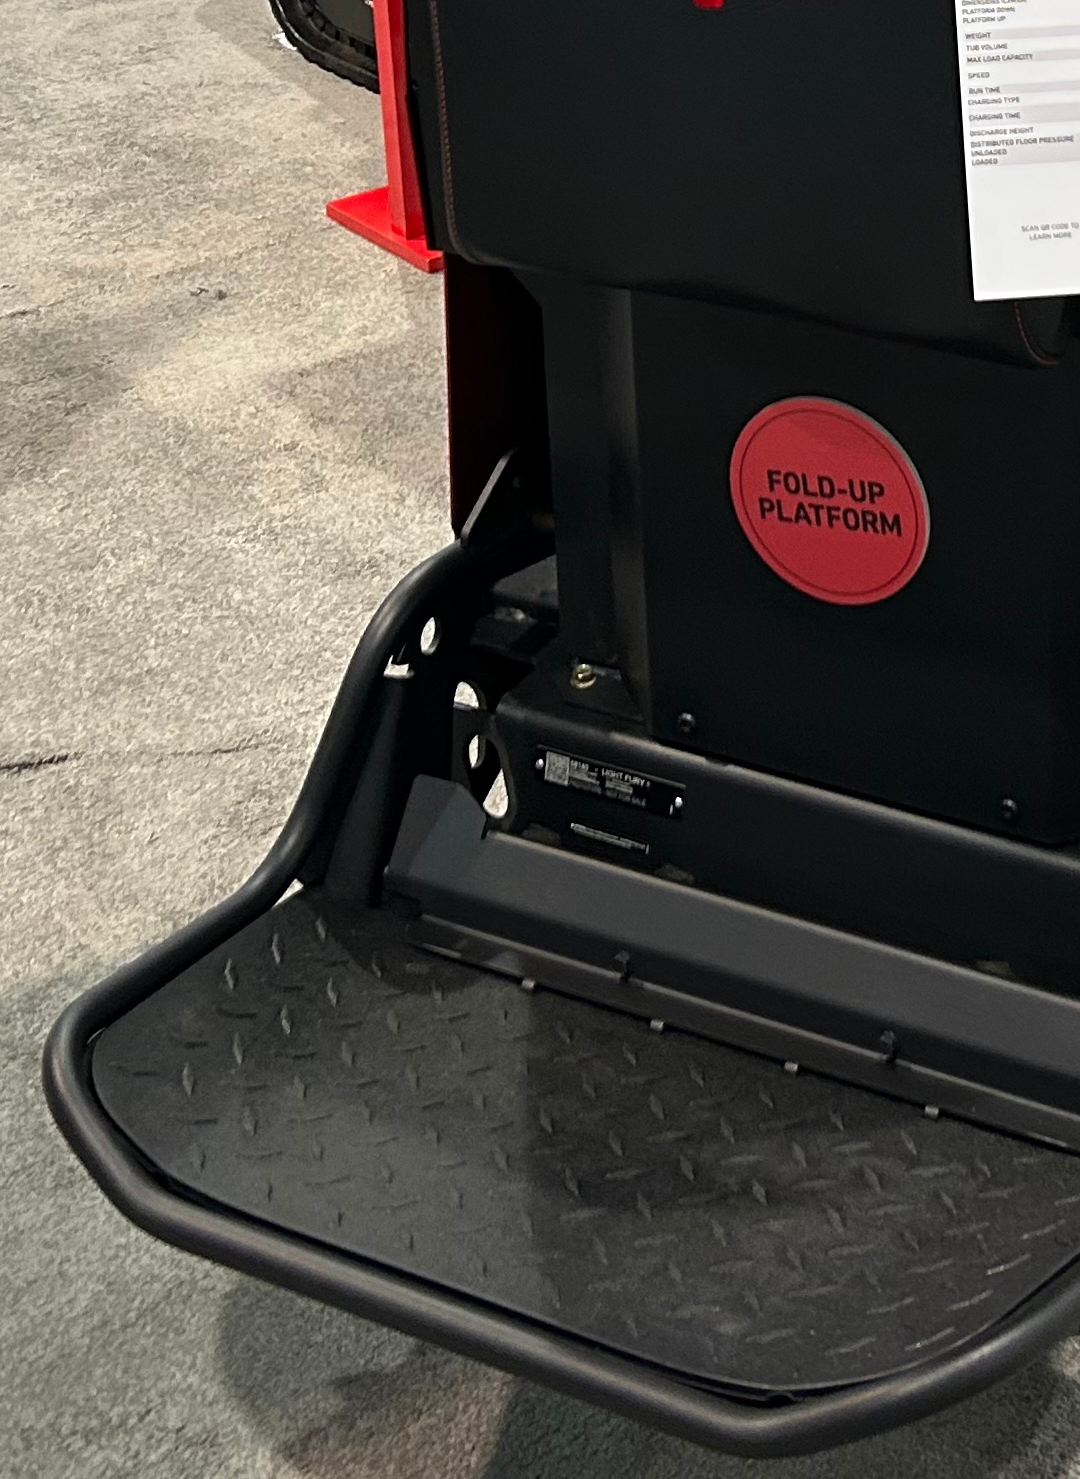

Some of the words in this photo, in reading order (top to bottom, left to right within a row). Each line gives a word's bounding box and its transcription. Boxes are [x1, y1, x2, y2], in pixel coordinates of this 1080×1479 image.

[967, 71, 990, 79] SPEED
[971, 157, 998, 166] LOADED
[1021, 224, 1039, 232] SCAN
[1050, 222, 1068, 230] CODE
[1028, 232, 1051, 240] LEARN
[1053, 231, 1071, 239] MORE
[766, 469, 885, 504] FOLD-UP
[758, 497, 902, 537] PLATFORM
